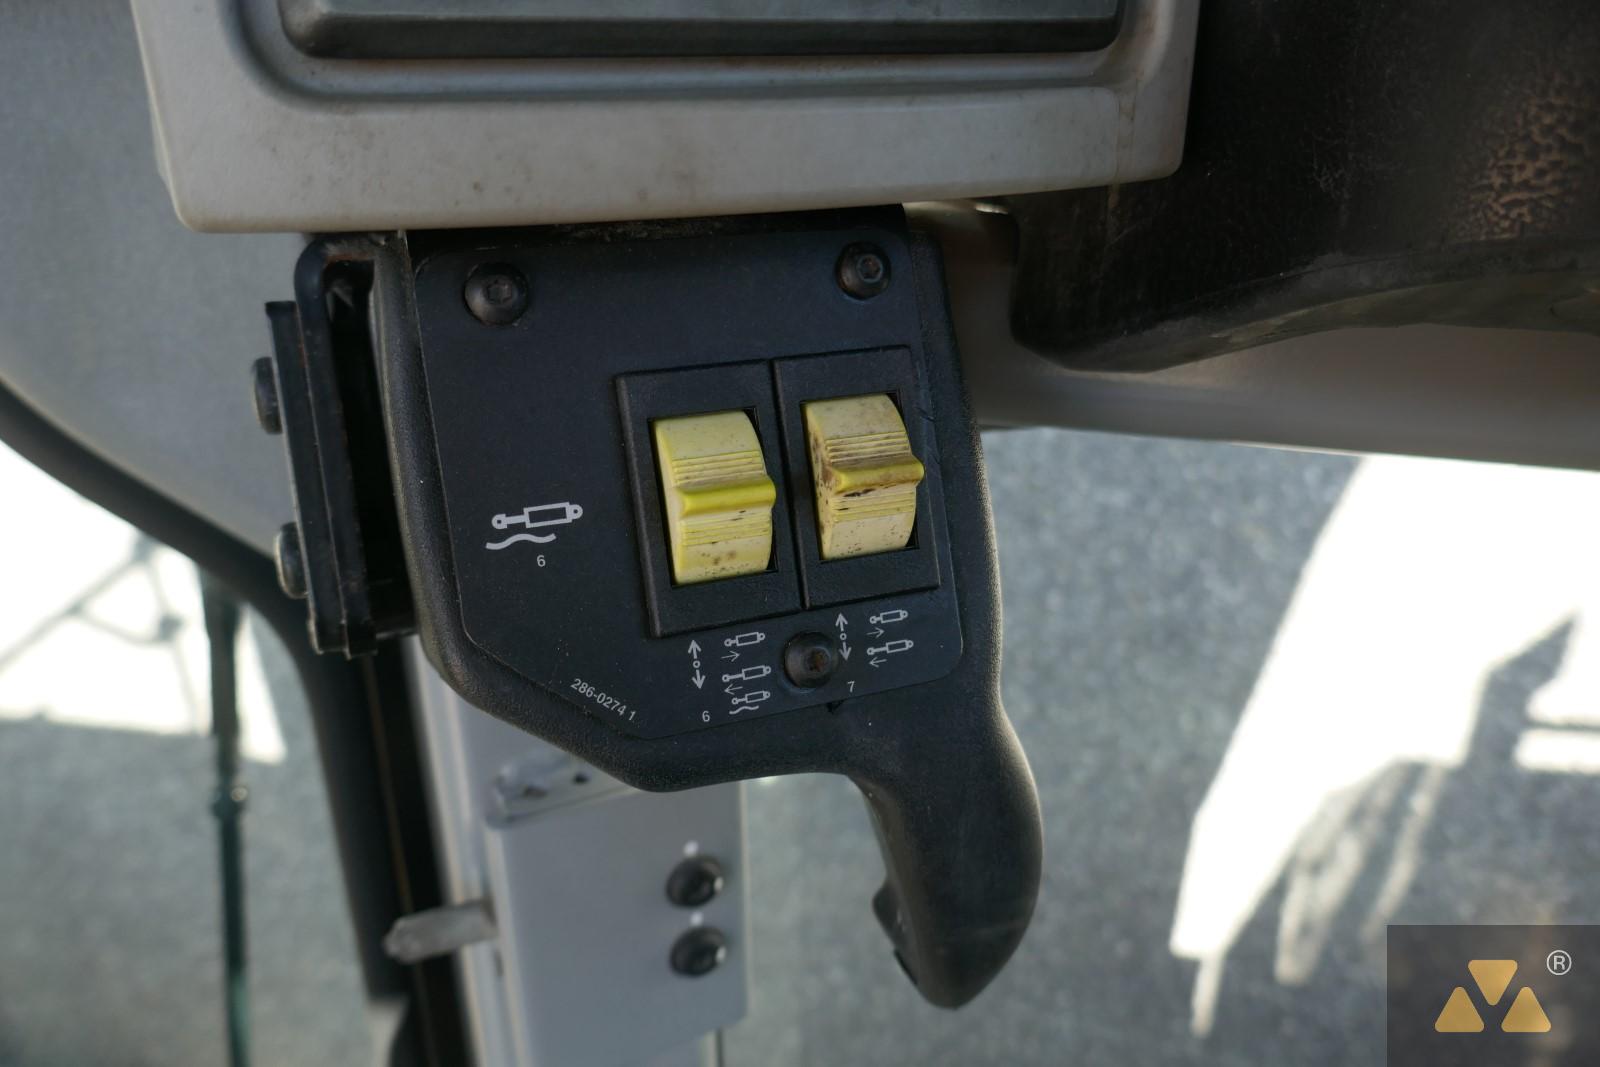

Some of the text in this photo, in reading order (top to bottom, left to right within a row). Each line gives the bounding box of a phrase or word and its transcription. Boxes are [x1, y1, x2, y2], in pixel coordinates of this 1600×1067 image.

[536, 554, 546, 567] 6
[847, 681, 855, 692] 7
[570, 678, 636, 720] 286-0274 1
[702, 710, 710, 722] 6
